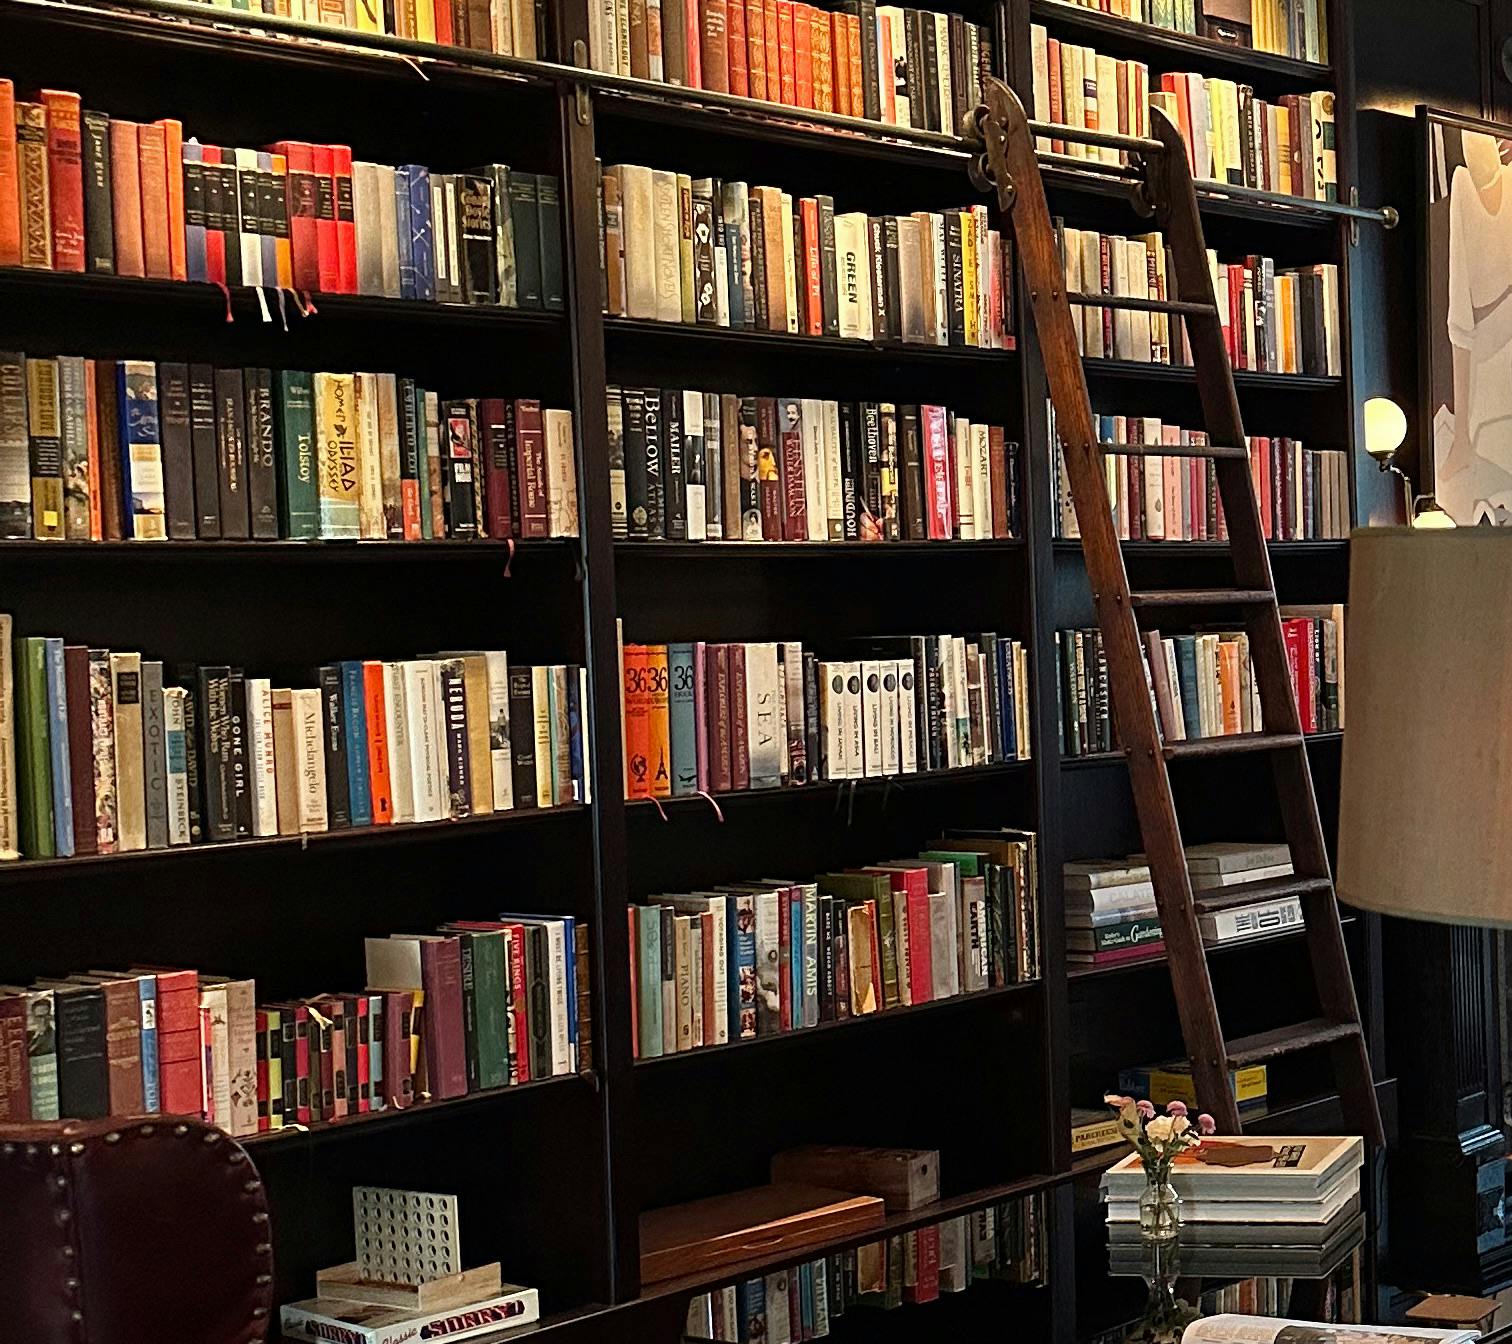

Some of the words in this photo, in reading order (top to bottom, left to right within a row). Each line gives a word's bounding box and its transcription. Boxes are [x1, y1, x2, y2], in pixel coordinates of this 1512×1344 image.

[872, 223, 881, 253] Chuck
[846, 251, 858, 304] GREEN
[875, 254, 884, 307] Klosterman
[953, 254, 963, 312] SINATRA
[63, 361, 73, 404] THOMAS
[65, 406, 75, 445] CAHILL
[260, 388, 273, 467] BRANDO
[866, 408, 878, 463] Beethoven
[298, 432, 311, 484] Tolstoy
[328, 440, 338, 492] ODYSSEY
[339, 441, 356, 491] ILIAD
[523, 440, 536, 480] Imperial
[669, 421, 681, 474] MAILER
[979, 430, 988, 477] MOZART
[527, 481, 537, 508] Rome
[648, 483, 656, 523] ATLAS
[209, 679, 219, 703] With
[219, 678, 229, 714] Women
[626, 667, 647, 694] 36
[647, 666, 667, 693] 36
[674, 665, 694, 691] 36
[1098, 649, 1108, 720] LANCASTER
[210, 704, 219, 720] the
[262, 690, 271, 725] ALICE
[328, 693, 339, 724] Walker
[448, 678, 465, 730] NERUDA
[757, 692, 773, 746] SEA
[149, 689, 161, 790] EXOTIC
[220, 715, 230, 740] Who
[232, 715, 242, 755] GONE
[187, 749, 198, 787] DAVID
[221, 742, 230, 761] Run
[264, 732, 273, 774] MUNRO
[304, 712, 320, 794] Michelangelo
[235, 763, 244, 797] GIRL
[175, 778, 187, 838] STEINBECK
[806, 888, 817, 944] MARTIN
[969, 901, 979, 950] EARTH
[512, 933, 520, 954] FIVE
[977, 900, 988, 976] AMERICAN
[462, 947, 474, 992] DESIRE
[513, 958, 522, 990] RINGS
[680, 964, 690, 1006] PIANO
[806, 956, 817, 995] AMIS
[430, 1300, 521, 1338] SORRY!
